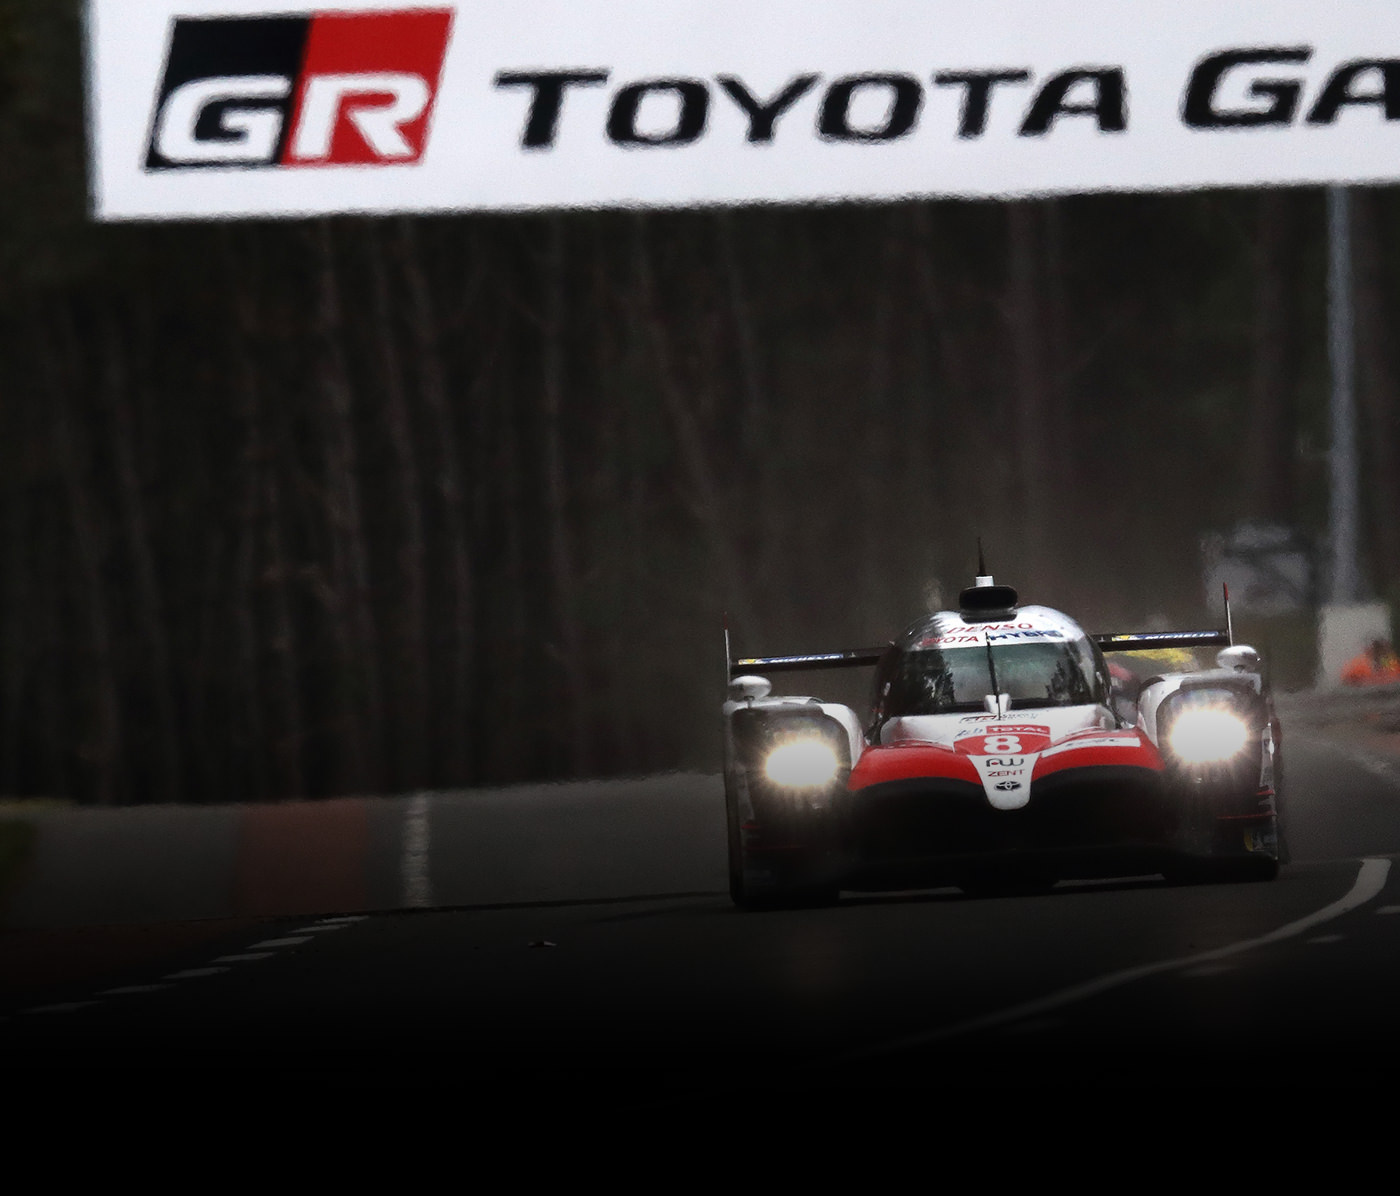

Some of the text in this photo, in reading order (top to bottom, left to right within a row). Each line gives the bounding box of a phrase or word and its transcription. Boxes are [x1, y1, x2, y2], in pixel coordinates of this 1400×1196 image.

[157, 73, 430, 161] GR
[492, 66, 1130, 151] TOYOTA
[946, 622, 1034, 634] DENSO
[984, 735, 1022, 754] 8
[987, 768, 1026, 777] ZENT
